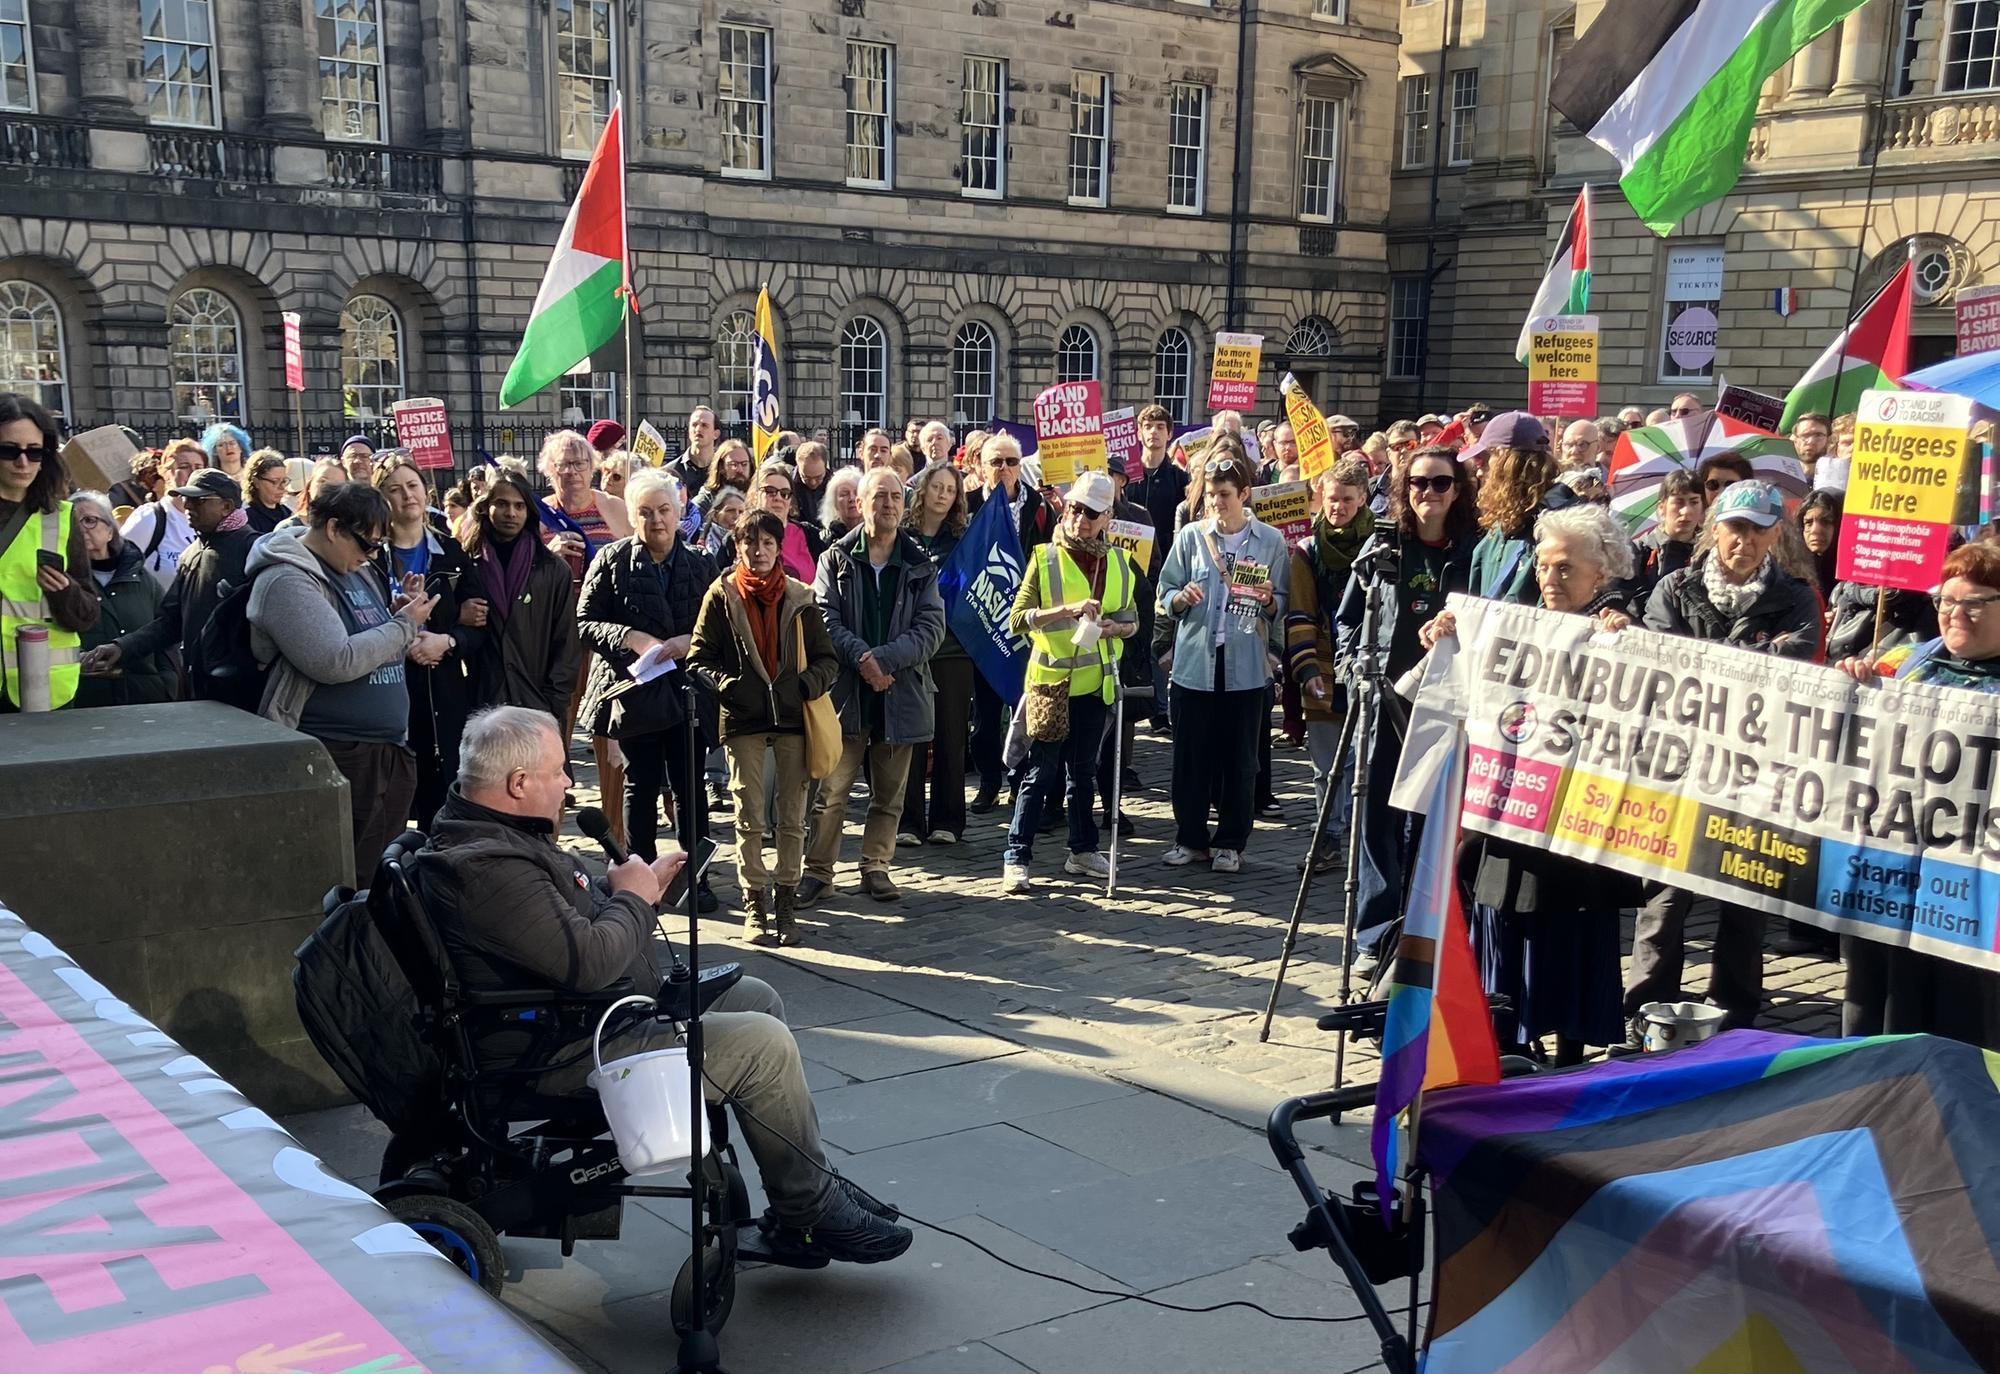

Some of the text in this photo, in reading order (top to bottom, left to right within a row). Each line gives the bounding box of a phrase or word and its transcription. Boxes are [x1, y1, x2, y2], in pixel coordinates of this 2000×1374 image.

[1960, 322, 1970, 336] 4
[1218, 347, 1251, 358] No more
[1534, 334, 1593, 351] Refugees
[1216, 358, 1252, 369] deaths in
[1536, 350, 1591, 363] welcome
[1215, 369, 1246, 381] custody
[1549, 364, 1578, 377] here
[1037, 385, 1088, 406] STAND
[1213, 381, 1254, 394] No justice
[1211, 394, 1248, 404] no peace
[400, 410, 444, 425] JUSTICE
[1037, 404, 1061, 421] UP
[1063, 400, 1085, 418] TO
[1910, 411, 1945, 423] RACISM
[401, 422, 446, 437] 4 SHEKU
[1040, 415, 1100, 437] RACISM
[402, 436, 439, 449] BAYOH
[1107, 434, 1136, 453] HEKU
[1858, 427, 1957, 461] Refugees
[1858, 458, 1947, 487] welcome
[1255, 495, 1304, 512] Refugees
[1870, 486, 1918, 514] here
[1288, 523, 1305, 534] the
[1858, 519, 1868, 529] No
[1868, 520, 1875, 530] to
[1112, 536, 1139, 552] ACK
[992, 632, 1012, 657] Union
[1719, 663, 1771, 688] Edinburgh
[1483, 637, 1729, 735] EDINBURGH
[1738, 692, 1767, 747] &
[1785, 701, 1877, 770] THE
[1468, 752, 1548, 792] Refugees
[1545, 709, 1690, 782] STAND
[1699, 744, 1760, 801] UP
[1770, 761, 1825, 823] TO
[1465, 785, 1537, 819] welcome
[1583, 784, 1667, 824] Say no to
[1560, 807, 1678, 859] Islamophobia
[1704, 815, 1808, 866] Black Lives
[1719, 851, 1784, 889] Matter
[1846, 855, 1970, 901] Stamp out
[1830, 887, 1979, 937] antisemitism
